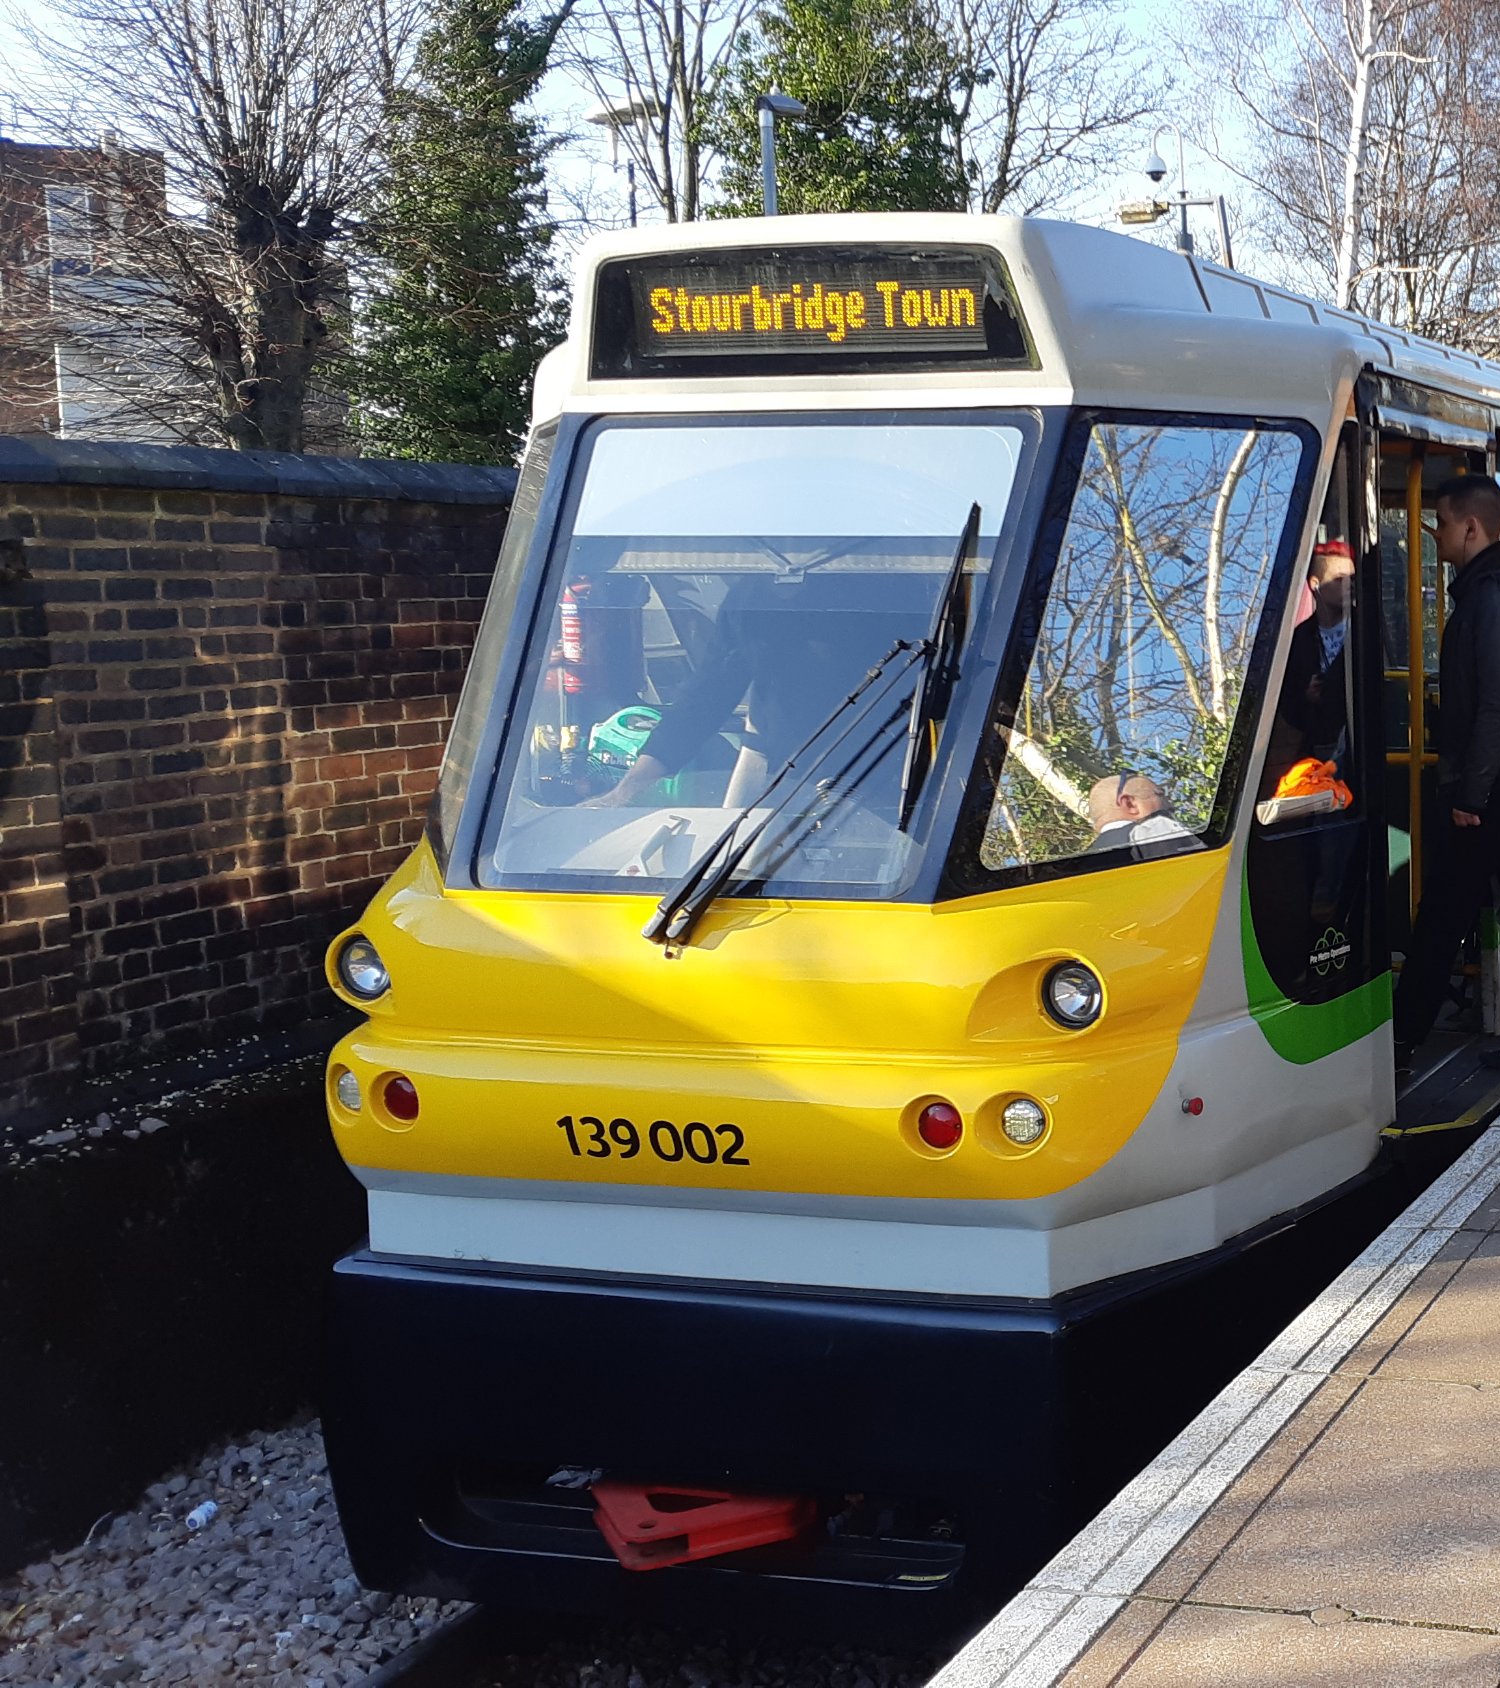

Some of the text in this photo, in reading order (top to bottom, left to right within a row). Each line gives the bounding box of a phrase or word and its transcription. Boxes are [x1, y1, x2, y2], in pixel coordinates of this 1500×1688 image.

[649, 281, 977, 343] Stourbridge Town
[556, 1115, 750, 1166] 139 002
